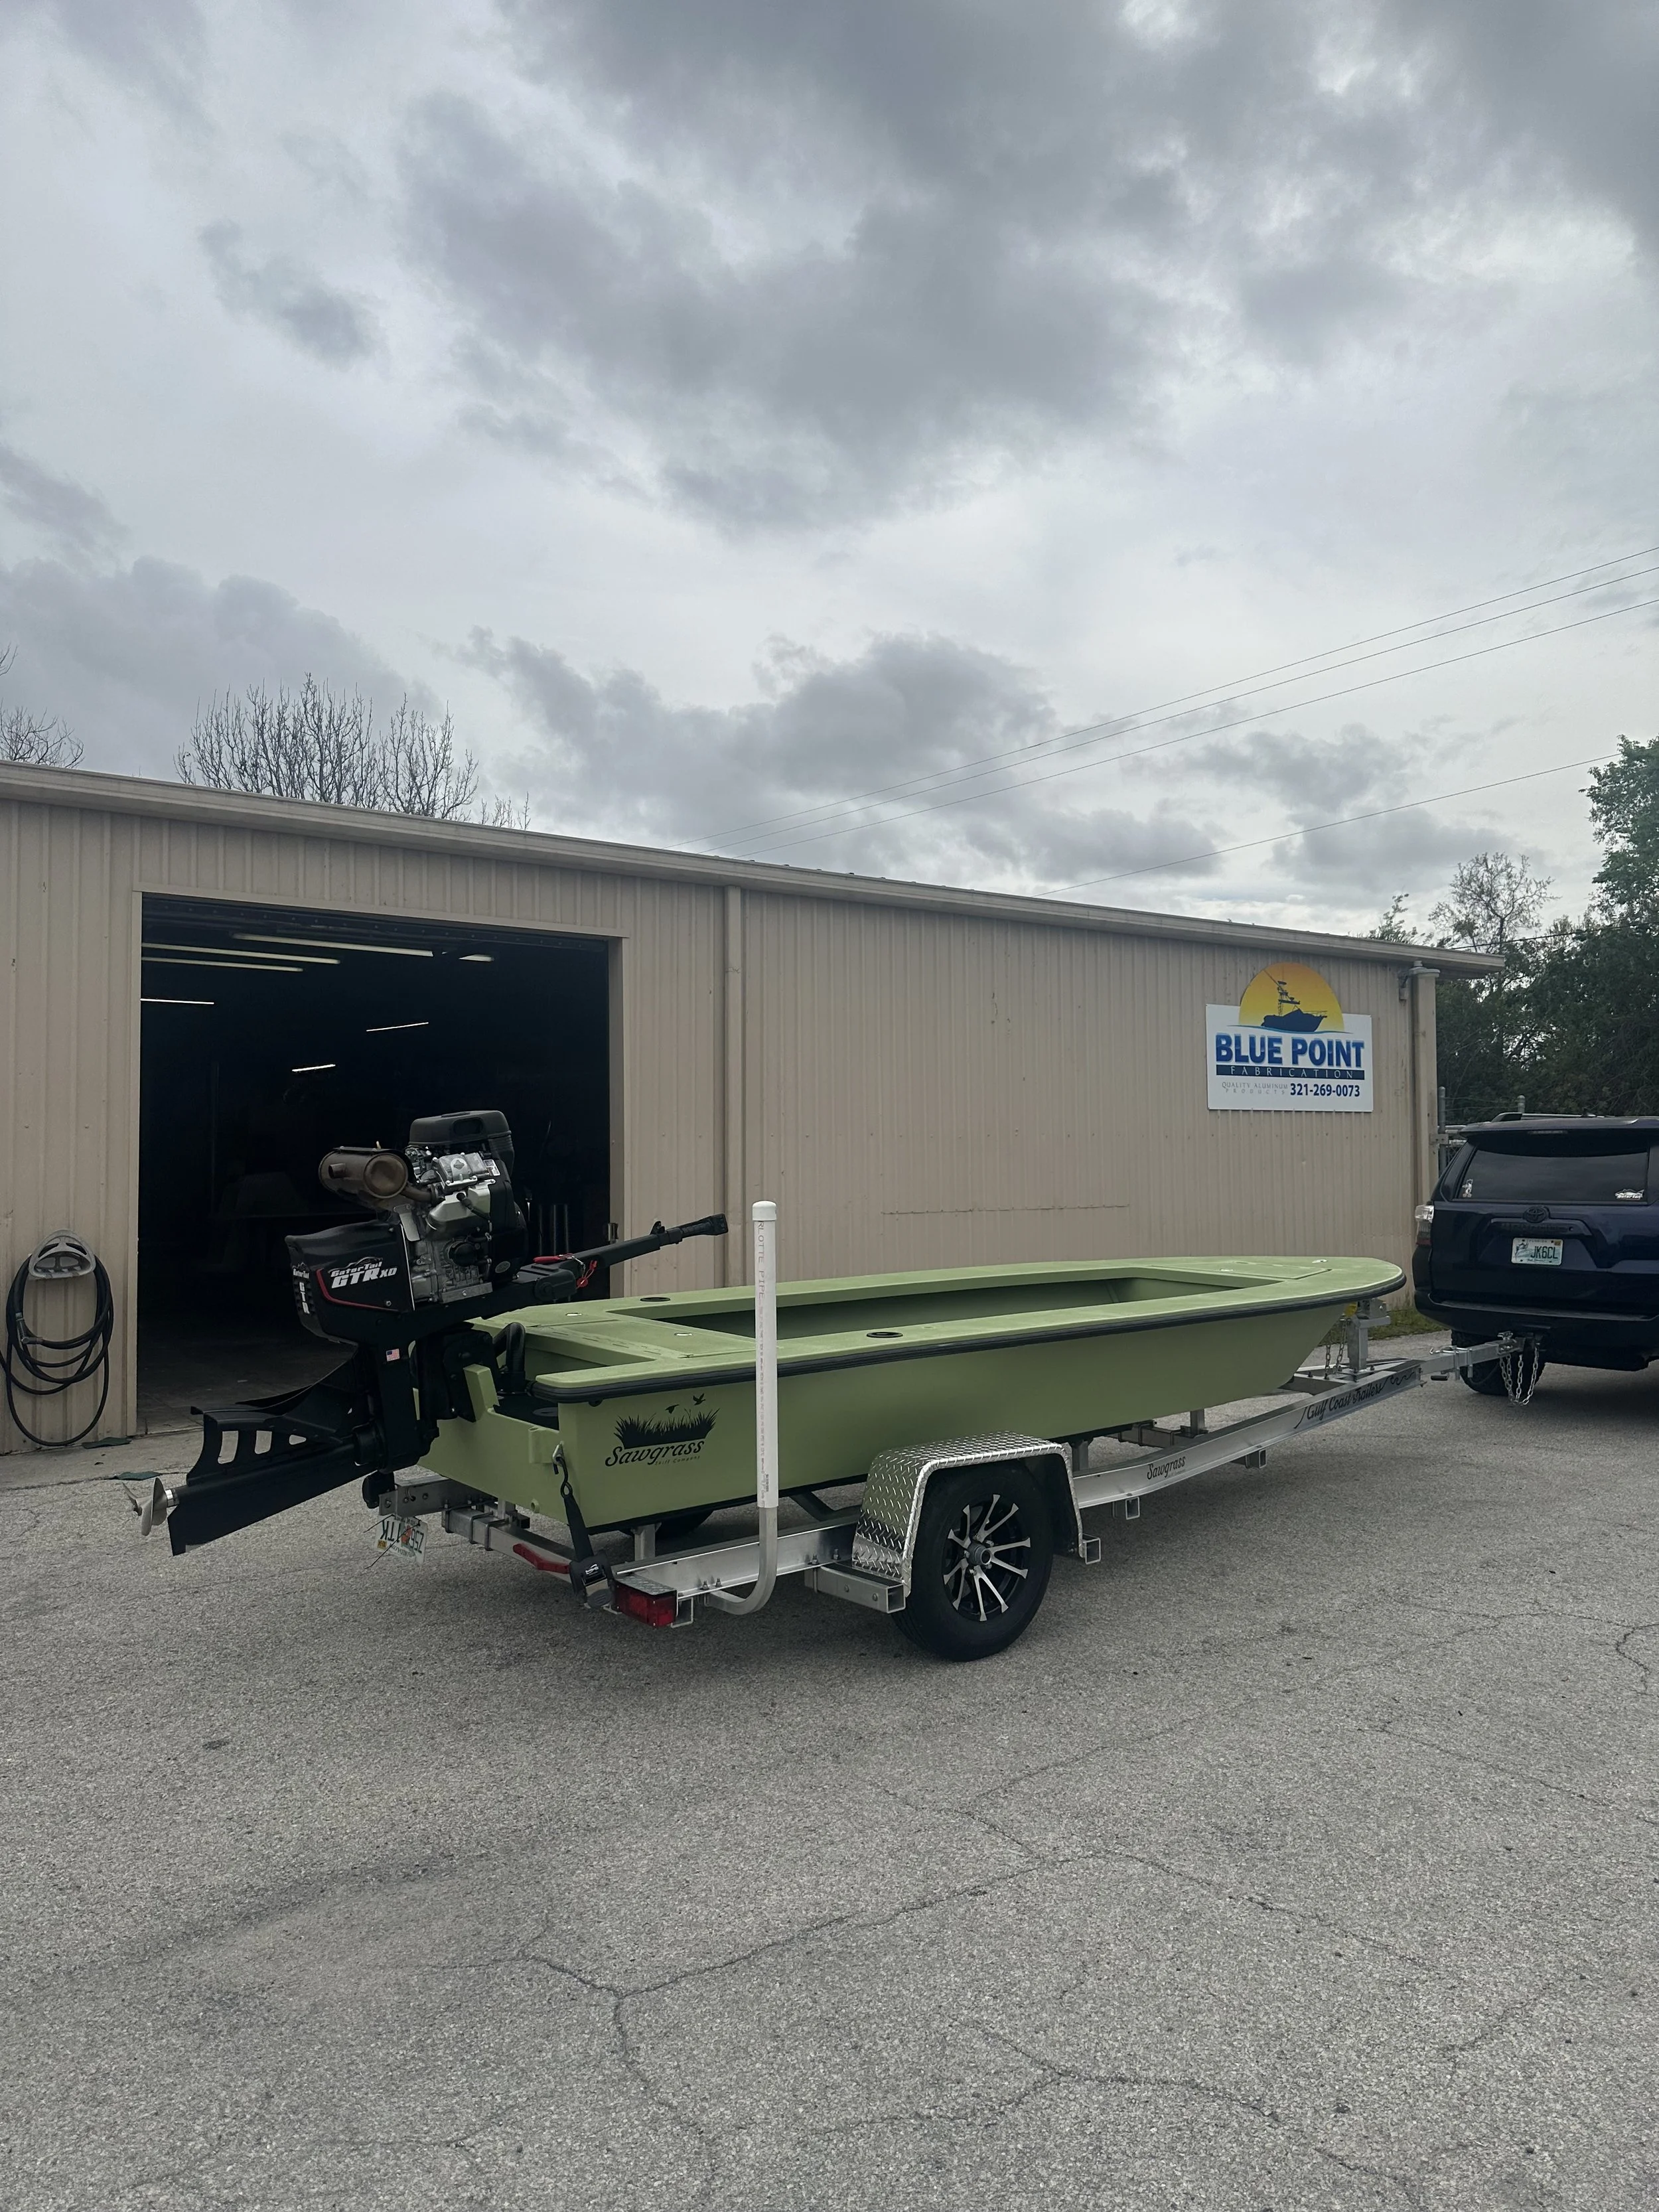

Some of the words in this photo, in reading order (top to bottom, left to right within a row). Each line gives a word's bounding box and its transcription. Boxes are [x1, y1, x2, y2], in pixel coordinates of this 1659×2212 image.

[1216, 1033, 1283, 1065] BLUE
[1291, 1037, 1364, 1068] POINT
[1230, 1067, 1354, 1078] FABRICATION
[1290, 1083, 1360, 1097] 321-269-0073
[1530, 1246, 1558, 1259] JK6CL
[332, 1268, 380, 1288] GTR
[1307, 1399, 1329, 1420] Gulf
[1329, 1394, 1352, 1412] Coast
[605, 1440, 705, 1467] Sawgrass
[1147, 1456, 1186, 1480] Sawgrass
